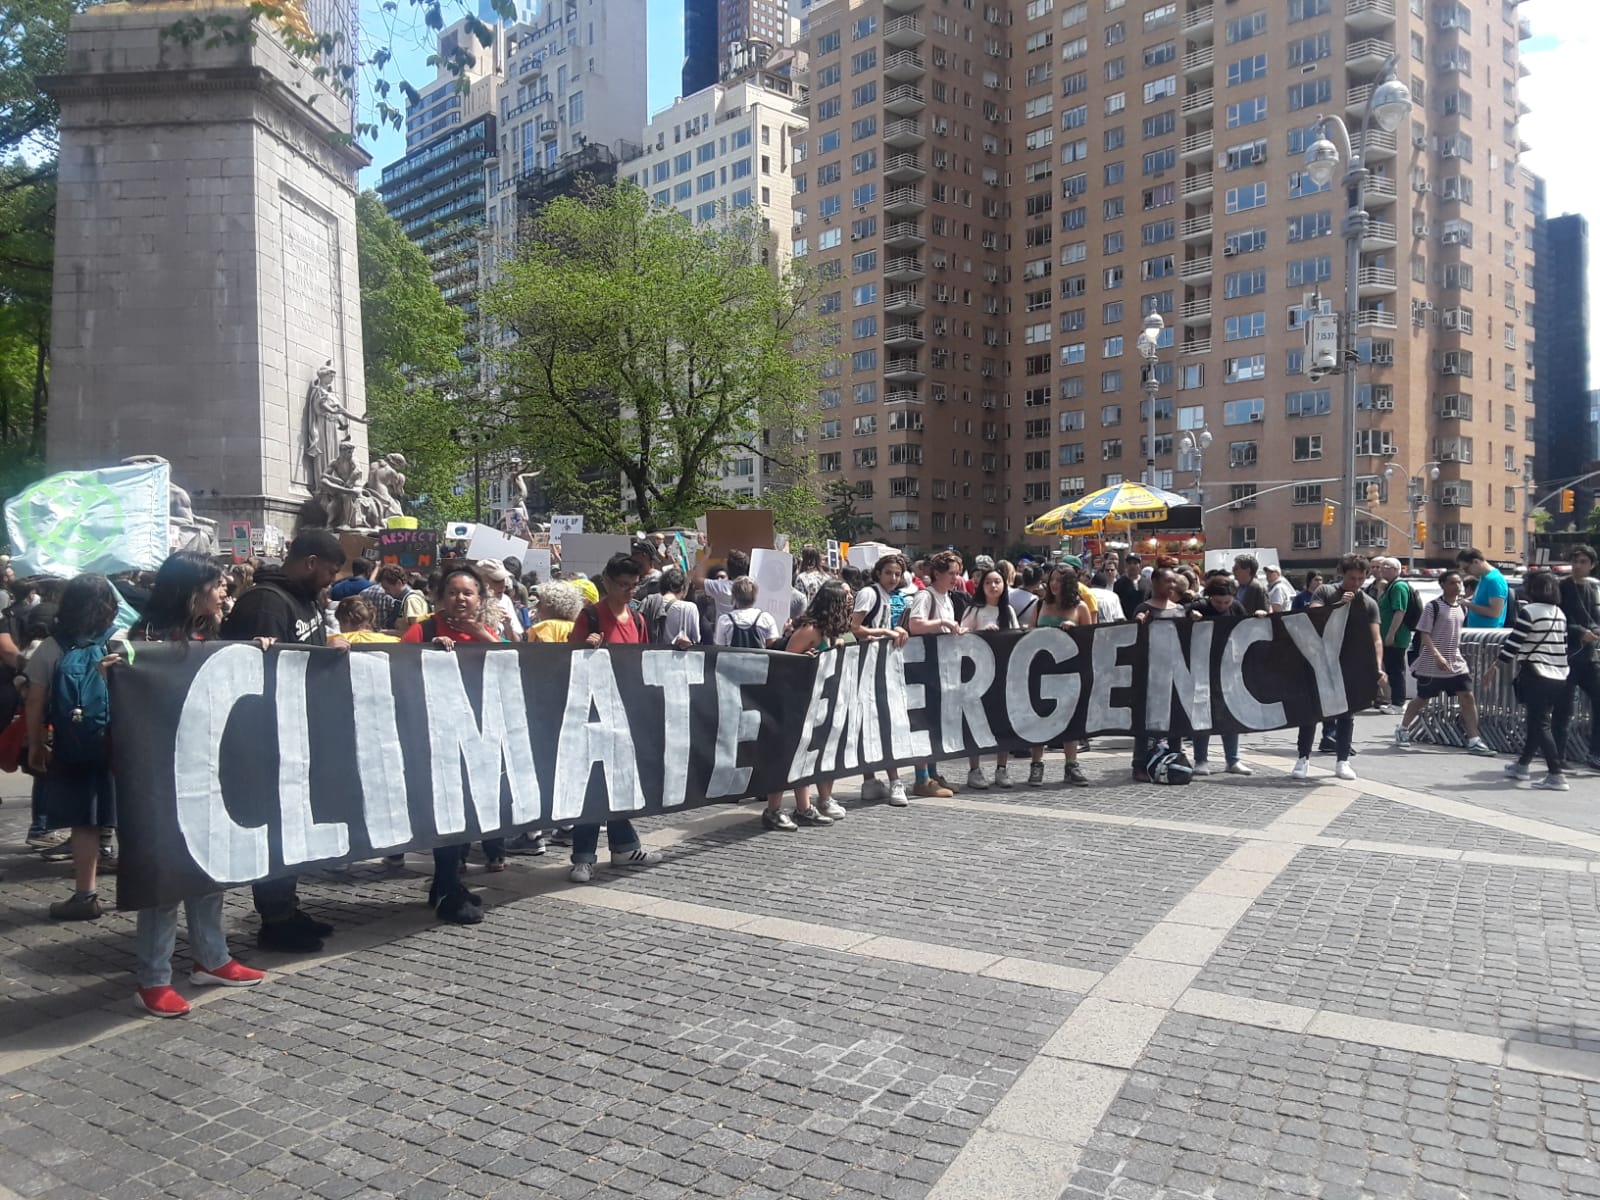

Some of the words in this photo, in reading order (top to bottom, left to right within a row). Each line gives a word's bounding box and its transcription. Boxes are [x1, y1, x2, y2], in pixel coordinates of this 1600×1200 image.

[1114, 510, 1164, 520] SABRETT
[381, 531, 436, 545] RESPECT
[175, 643, 770, 883] CLIMATE
[787, 601, 1352, 783] EMERGENCY
